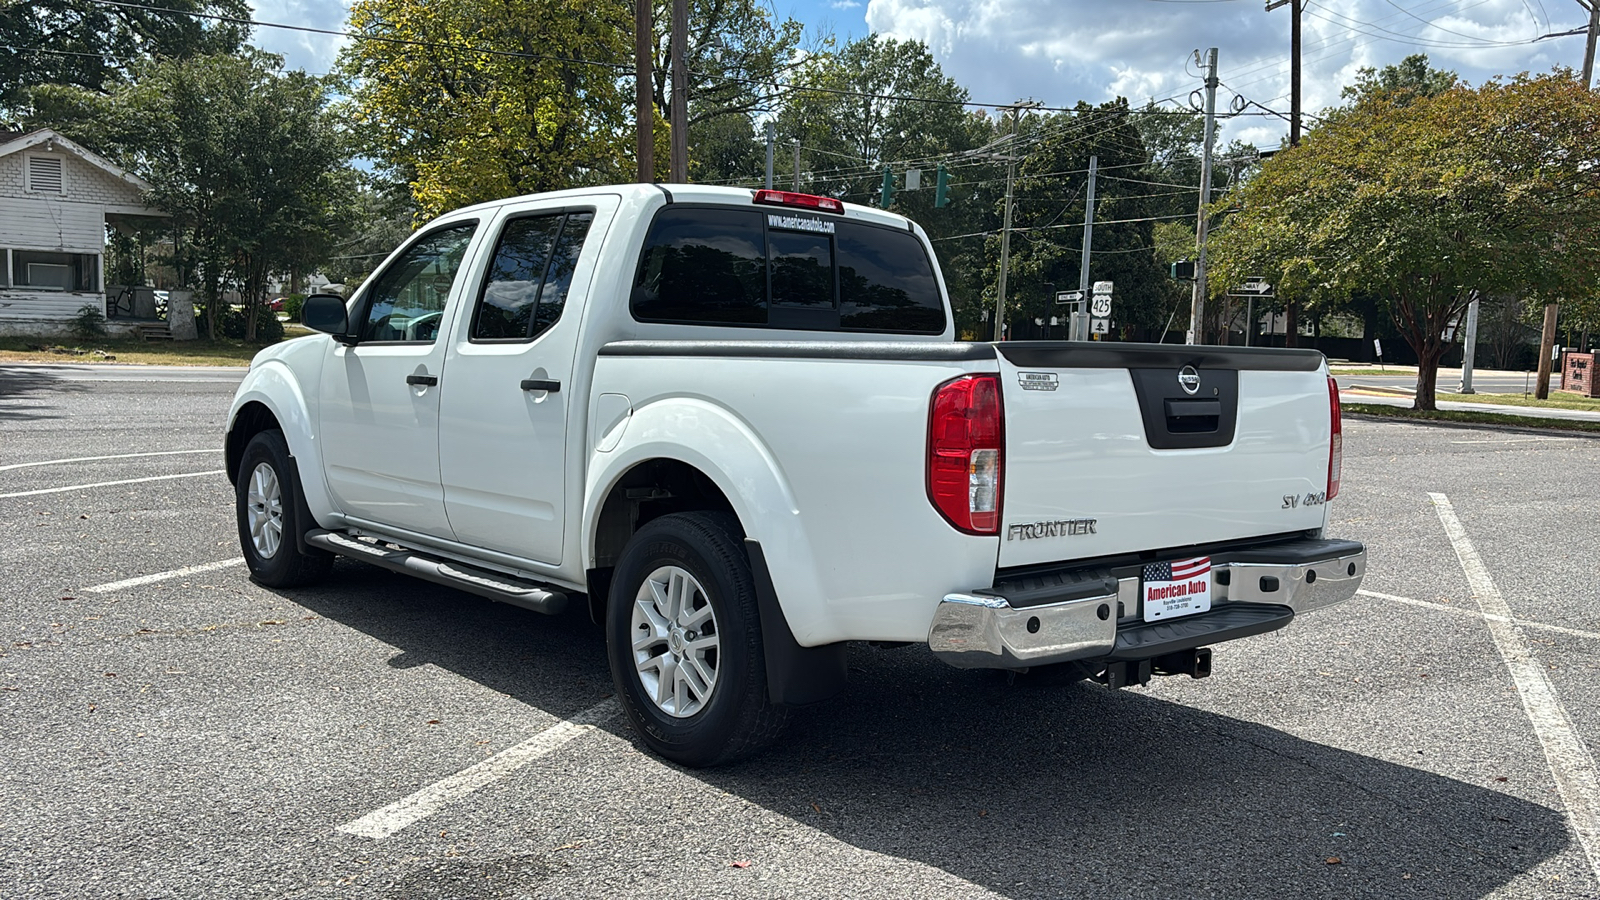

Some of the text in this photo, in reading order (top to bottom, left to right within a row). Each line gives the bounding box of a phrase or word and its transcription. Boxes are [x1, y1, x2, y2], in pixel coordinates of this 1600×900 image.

[767, 214, 835, 233] www.americanautola.com
[1094, 284, 1112, 292] SOUTH
[1093, 299, 1110, 313] 425
[1281, 494, 1300, 509] SV
[1007, 519, 1097, 541] FRONTIER
[1147, 581, 1206, 601] American Auto
